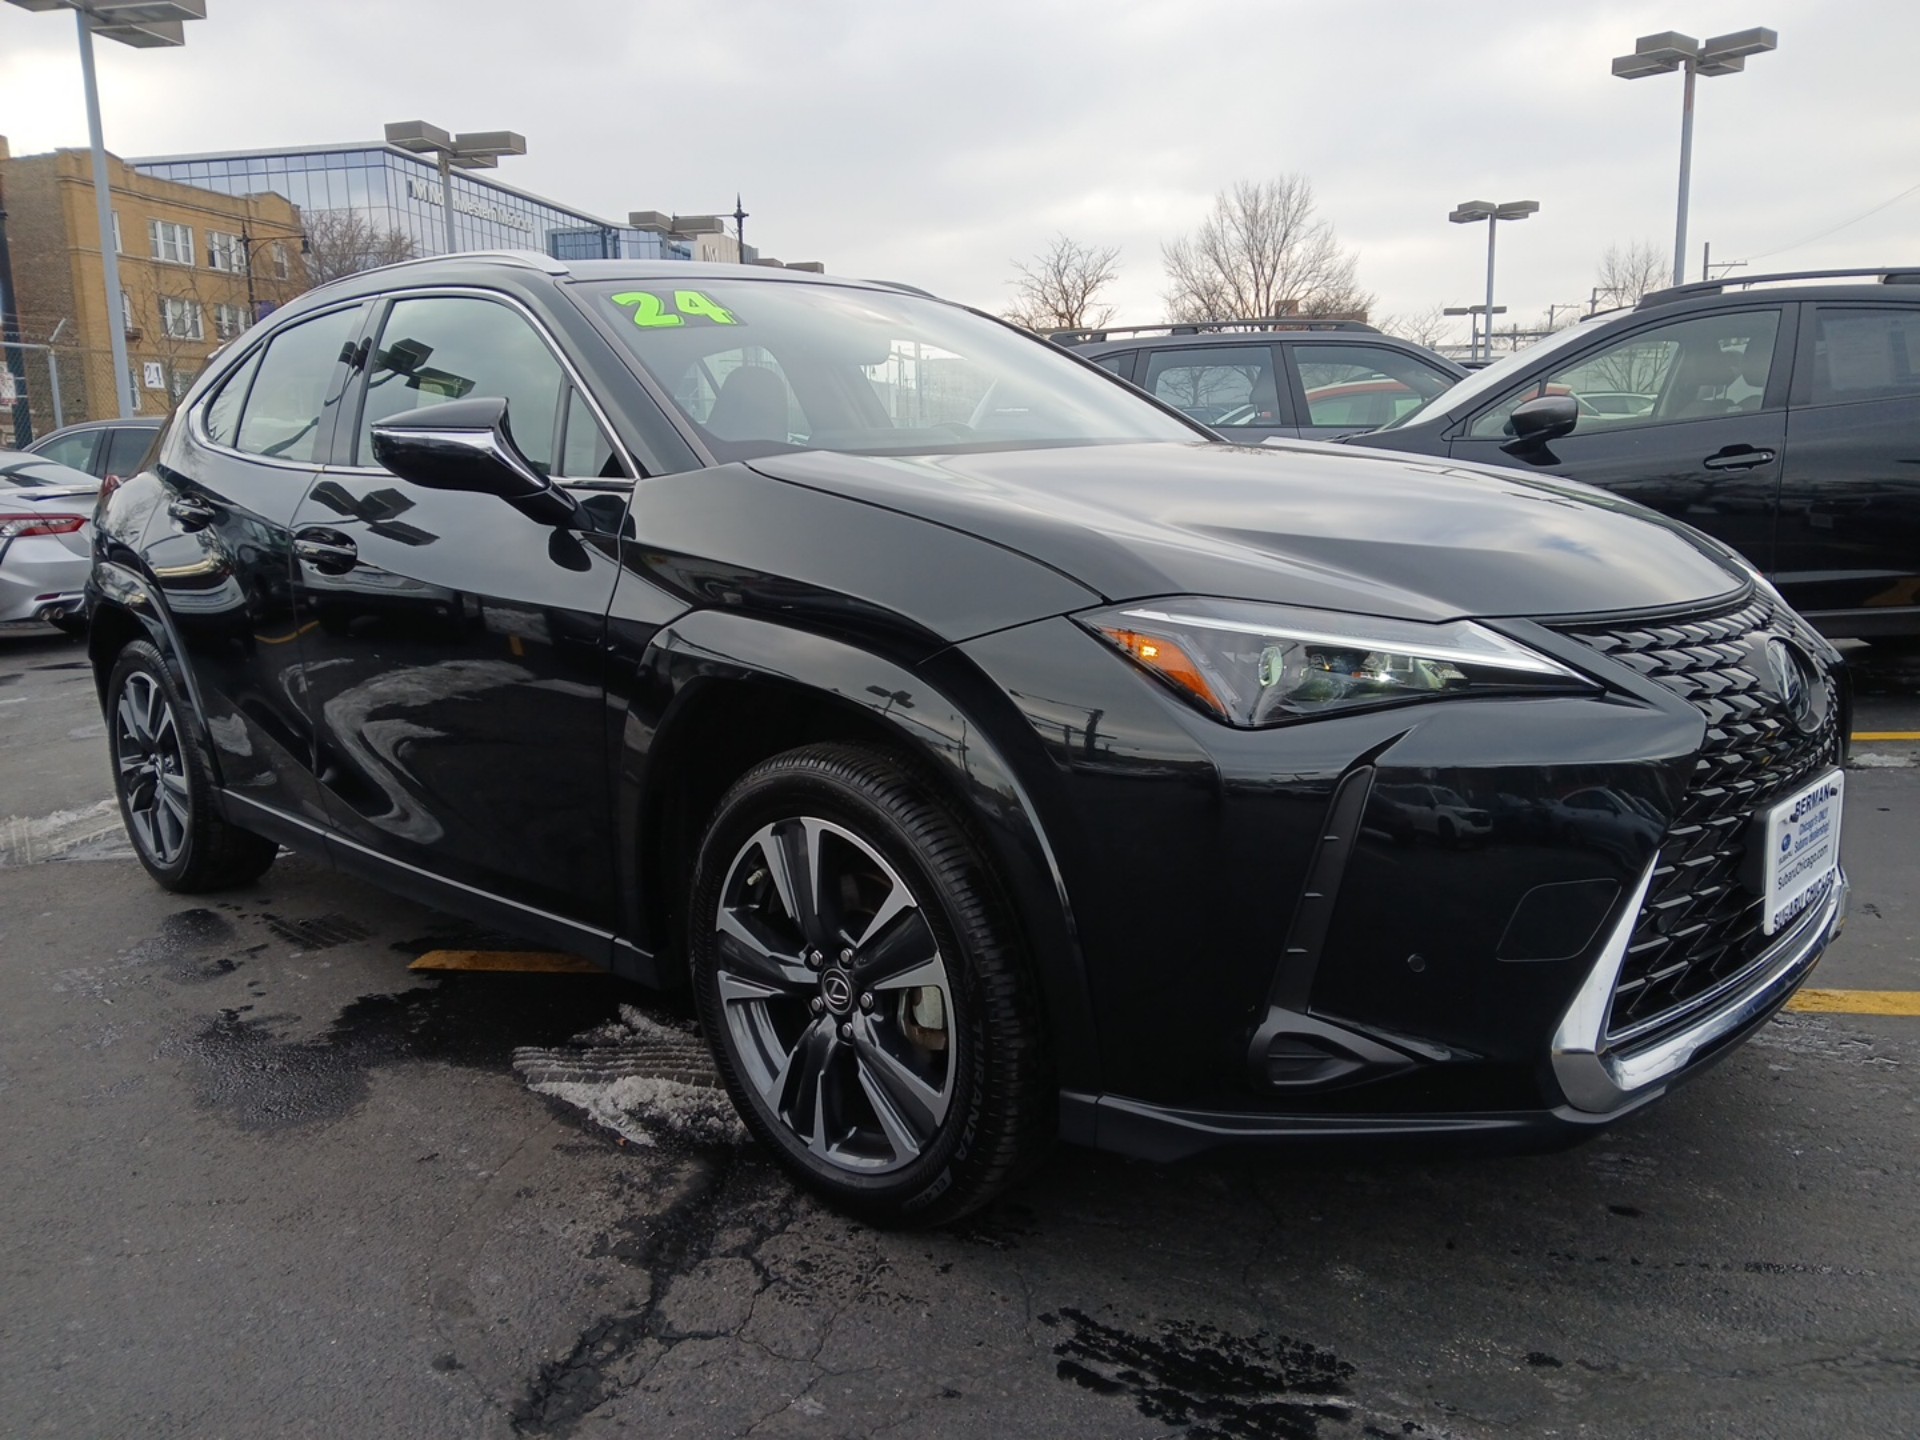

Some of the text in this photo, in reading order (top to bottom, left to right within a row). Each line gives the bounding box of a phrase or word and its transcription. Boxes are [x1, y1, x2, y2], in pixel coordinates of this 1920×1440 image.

[611, 290, 737, 327] 24
[1795, 782, 1830, 816] BERMAN
[1778, 844, 1829, 890] SubaruChicago.com
